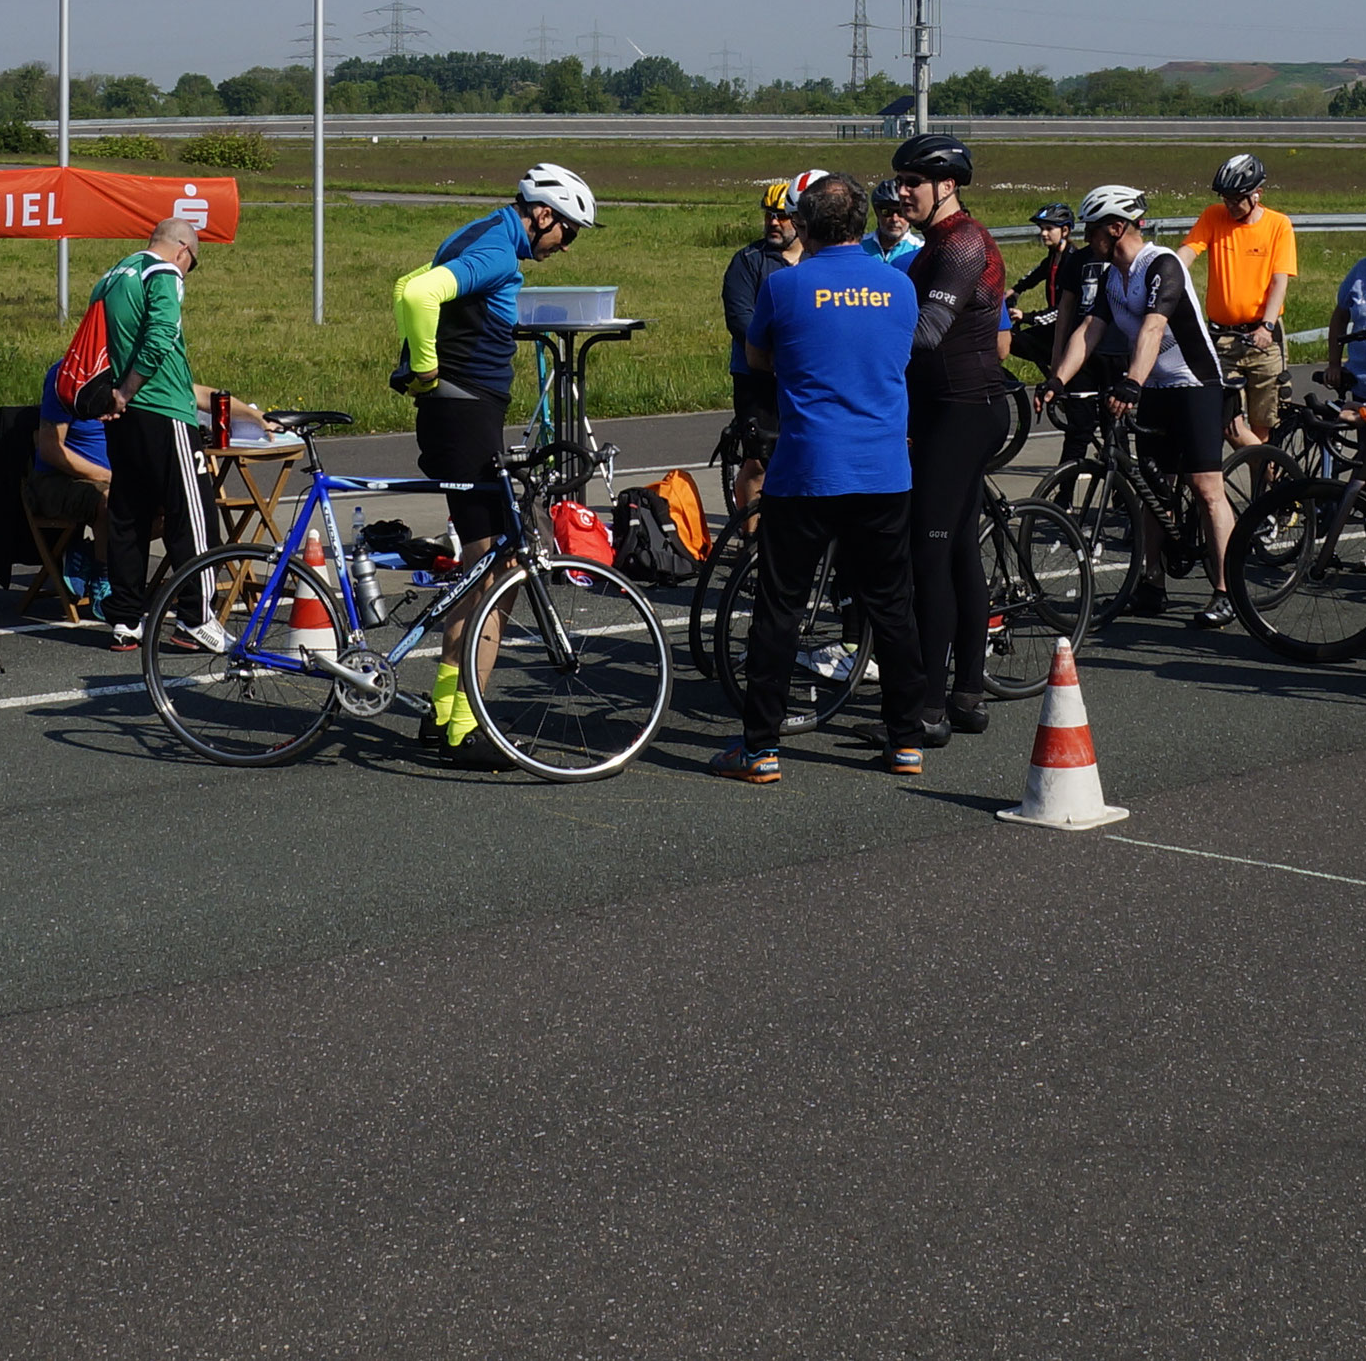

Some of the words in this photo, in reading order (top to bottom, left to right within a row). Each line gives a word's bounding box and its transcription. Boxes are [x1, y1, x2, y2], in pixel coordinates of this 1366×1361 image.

[815, 287, 892, 309] Prüfer
[928, 289, 958, 306] GORE
[194, 450, 207, 475] 2
[928, 529, 949, 539] GORE
[435, 554, 493, 614] RIDLEY
[196, 627, 220, 648] PUMA
